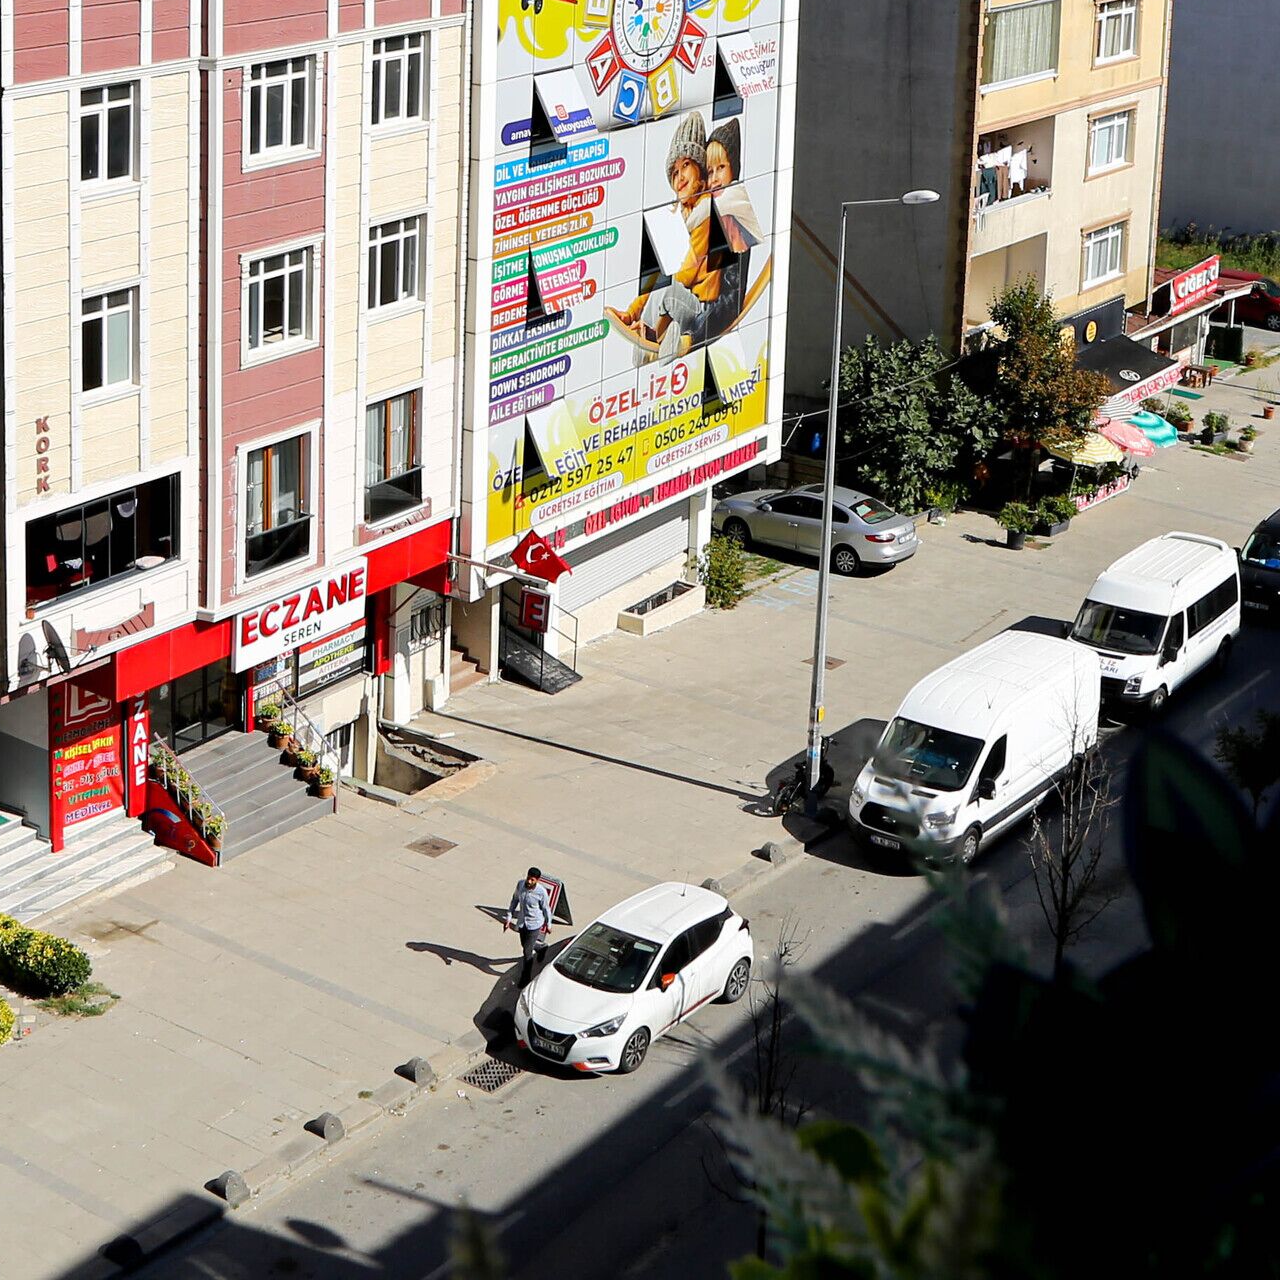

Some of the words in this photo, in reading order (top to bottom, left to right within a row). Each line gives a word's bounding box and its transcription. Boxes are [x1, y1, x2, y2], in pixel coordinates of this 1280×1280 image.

[496, 163, 511, 183] DİL
[512, 163, 524, 178] VE
[568, 141, 606, 162] TERAPİSİ
[495, 183, 527, 207] YAYGIN
[528, 173, 578, 196] GELİŞİMSEL
[580, 161, 622, 182] BOZUKLUK
[495, 212, 517, 231] ÖZEL
[518, 200, 560, 224] ÖĞRENME
[561, 187, 600, 213] GÜÇLÜĞÜ
[494, 257, 524, 281] İŞİTME
[571, 230, 615, 254] OZUKLUĞU
[495, 231, 534, 254] ZİHİNSEL
[535, 216, 589, 242] YETERSZLİK
[493, 283, 524, 300] GÖRME
[491, 339, 557, 376] HİPERAKTİVİTE
[558, 322, 604, 350] BOZUKLUĞU
[492, 329, 524, 351] DİKKAT
[491, 380, 518, 399] DOWN
[518, 359, 566, 387] SENDROMU
[588, 373, 667, 424] ÖZEL-İZ
[490, 403, 511, 422] AİLE
[512, 387, 546, 413] EĞİTİMİ
[35, 415, 50, 496] KORK
[654, 445, 693, 469] ÜCRETSİZ
[694, 431, 722, 451] SERVİS
[655, 424, 685, 449] 0506
[493, 465, 522, 491] ÖZE
[583, 433, 600, 453] VE
[530, 476, 562, 503] 0212
[567, 464, 592, 489] 597
[597, 455, 613, 475] 25
[617, 446, 634, 465] 47
[538, 491, 581, 520] ÜCRETSİZ
[584, 478, 616, 501] EĞİTİM
[240, 566, 365, 648] ECZANE
[283, 620, 322, 647] SEREN
[312, 632, 356, 658] PHARMACY
[313, 642, 356, 668] APOTHEKE
[133, 690, 148, 787] ZANE
